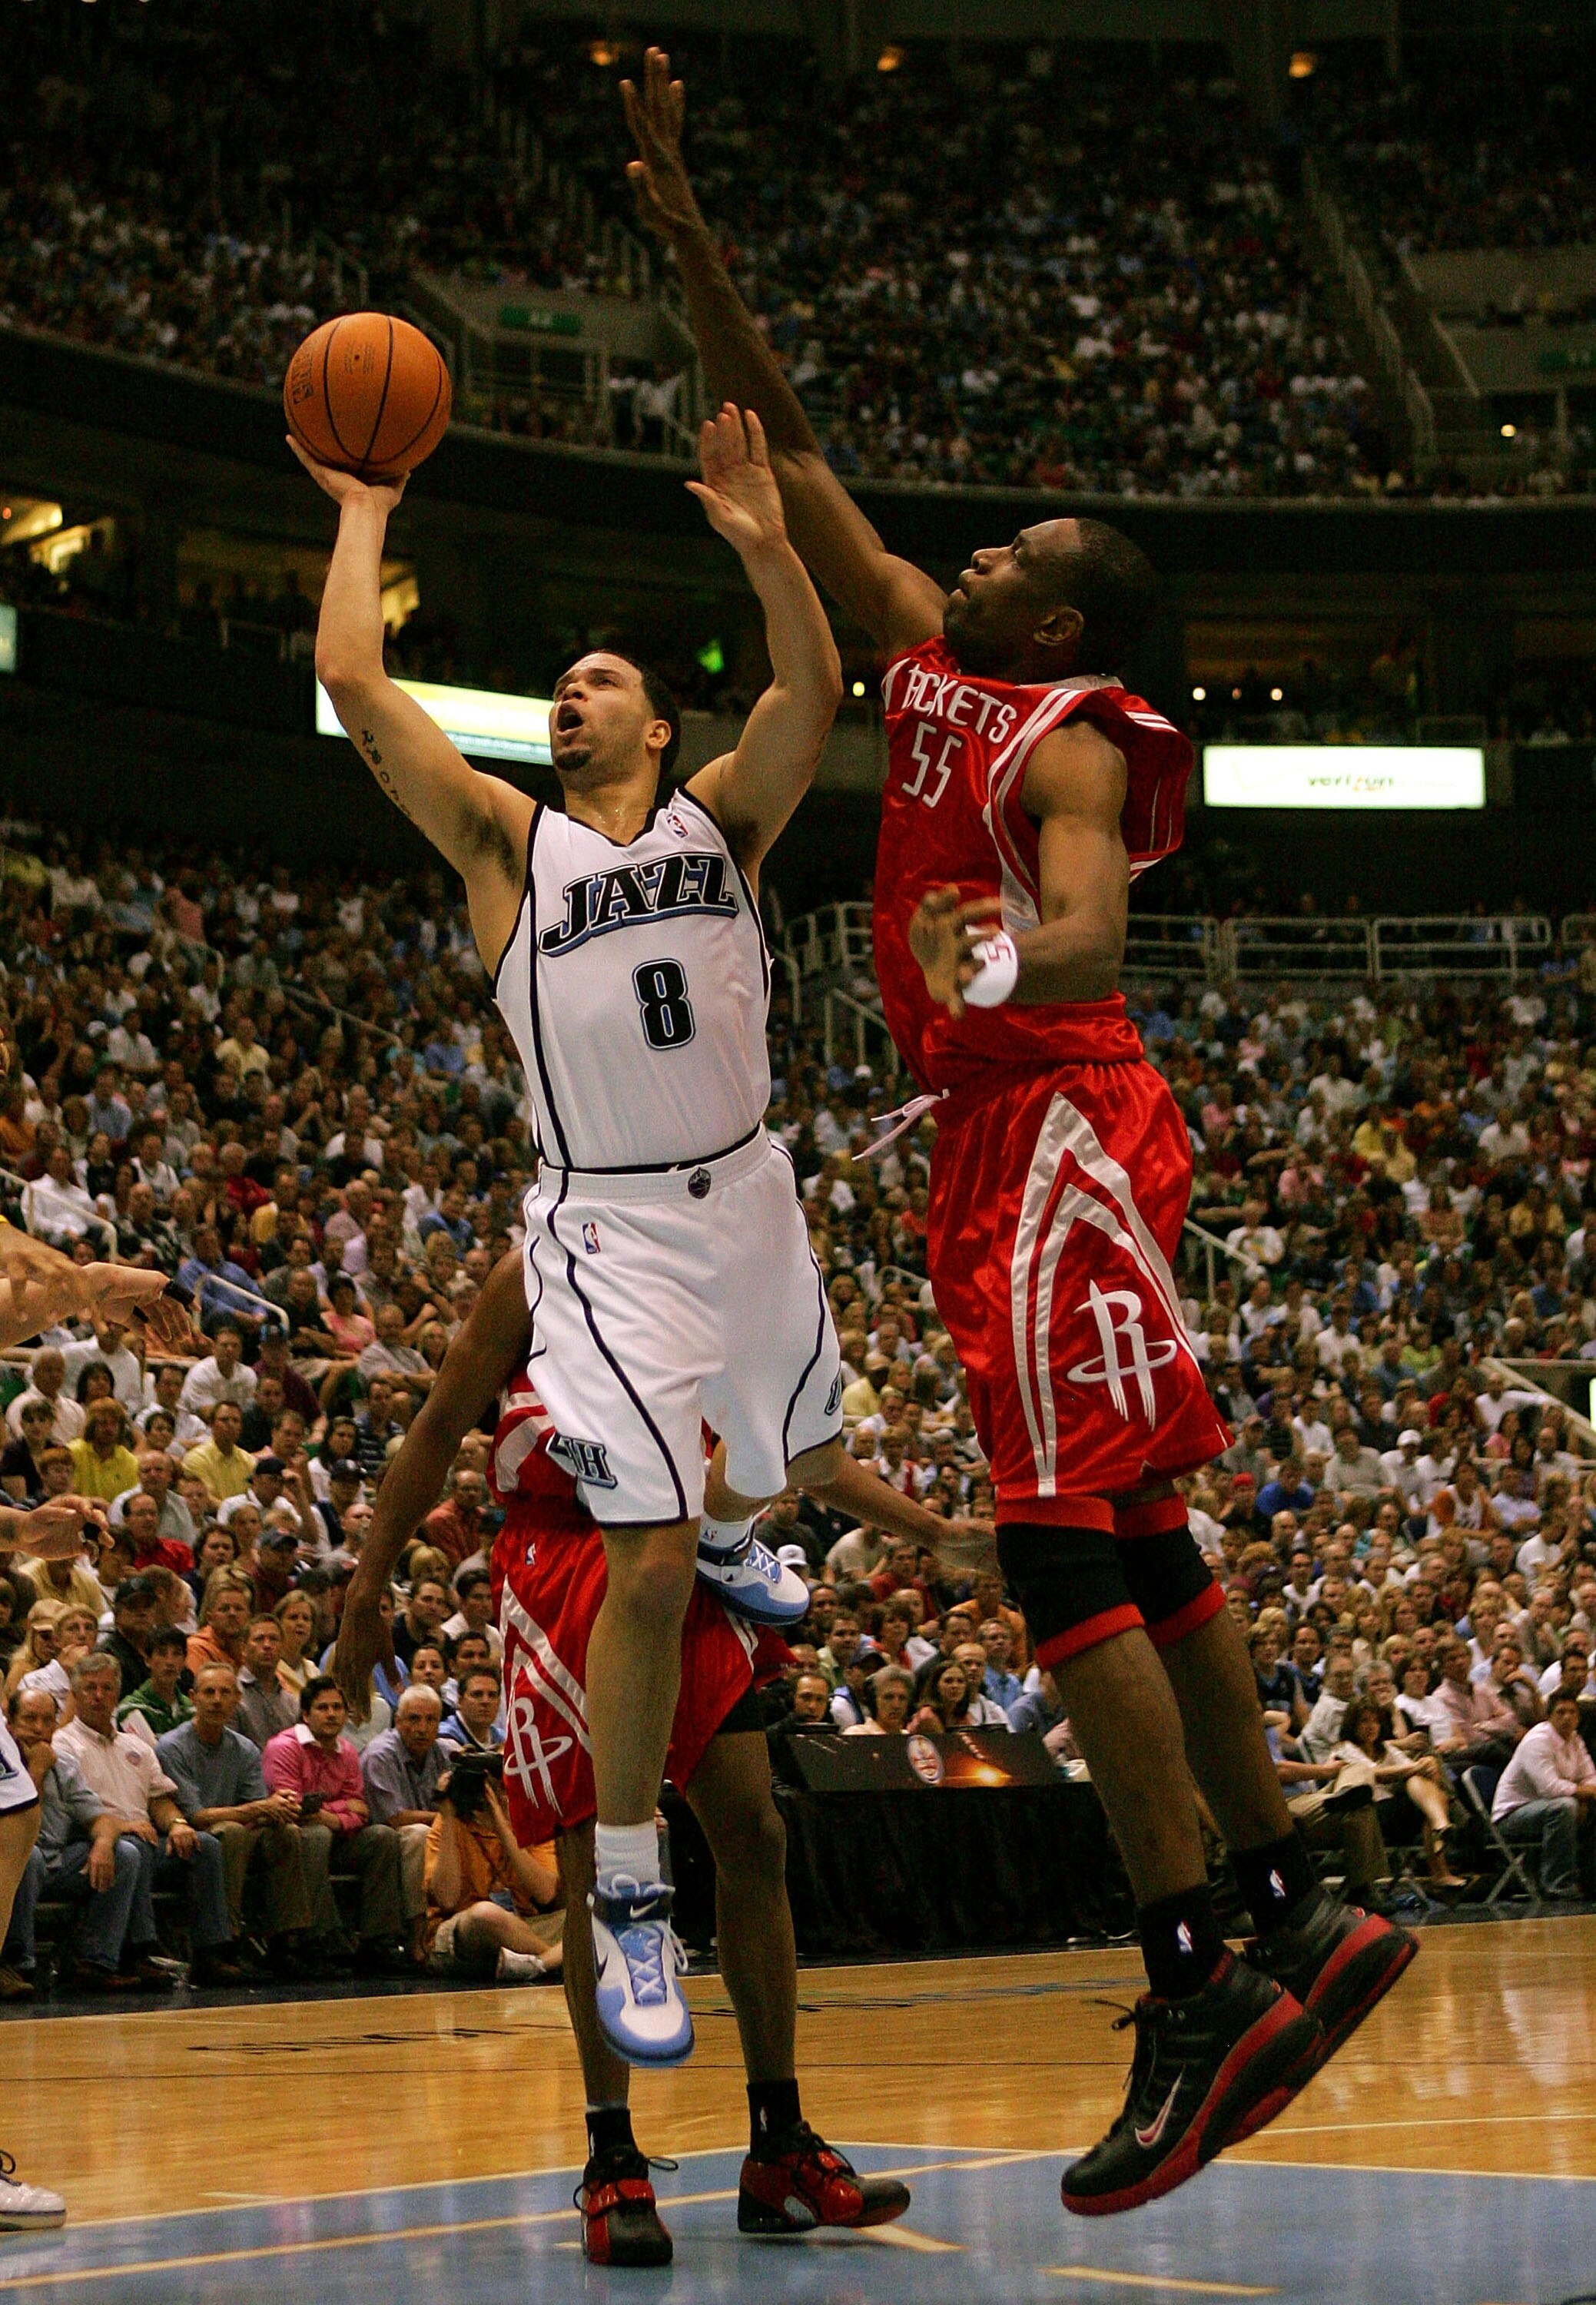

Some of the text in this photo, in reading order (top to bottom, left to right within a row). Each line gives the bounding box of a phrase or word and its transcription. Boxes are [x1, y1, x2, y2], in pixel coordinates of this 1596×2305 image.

[901, 663, 1017, 744] RCKETS
[901, 721, 962, 808] 55
[539, 852, 739, 957] JAZZ
[632, 958, 695, 1050] 8
